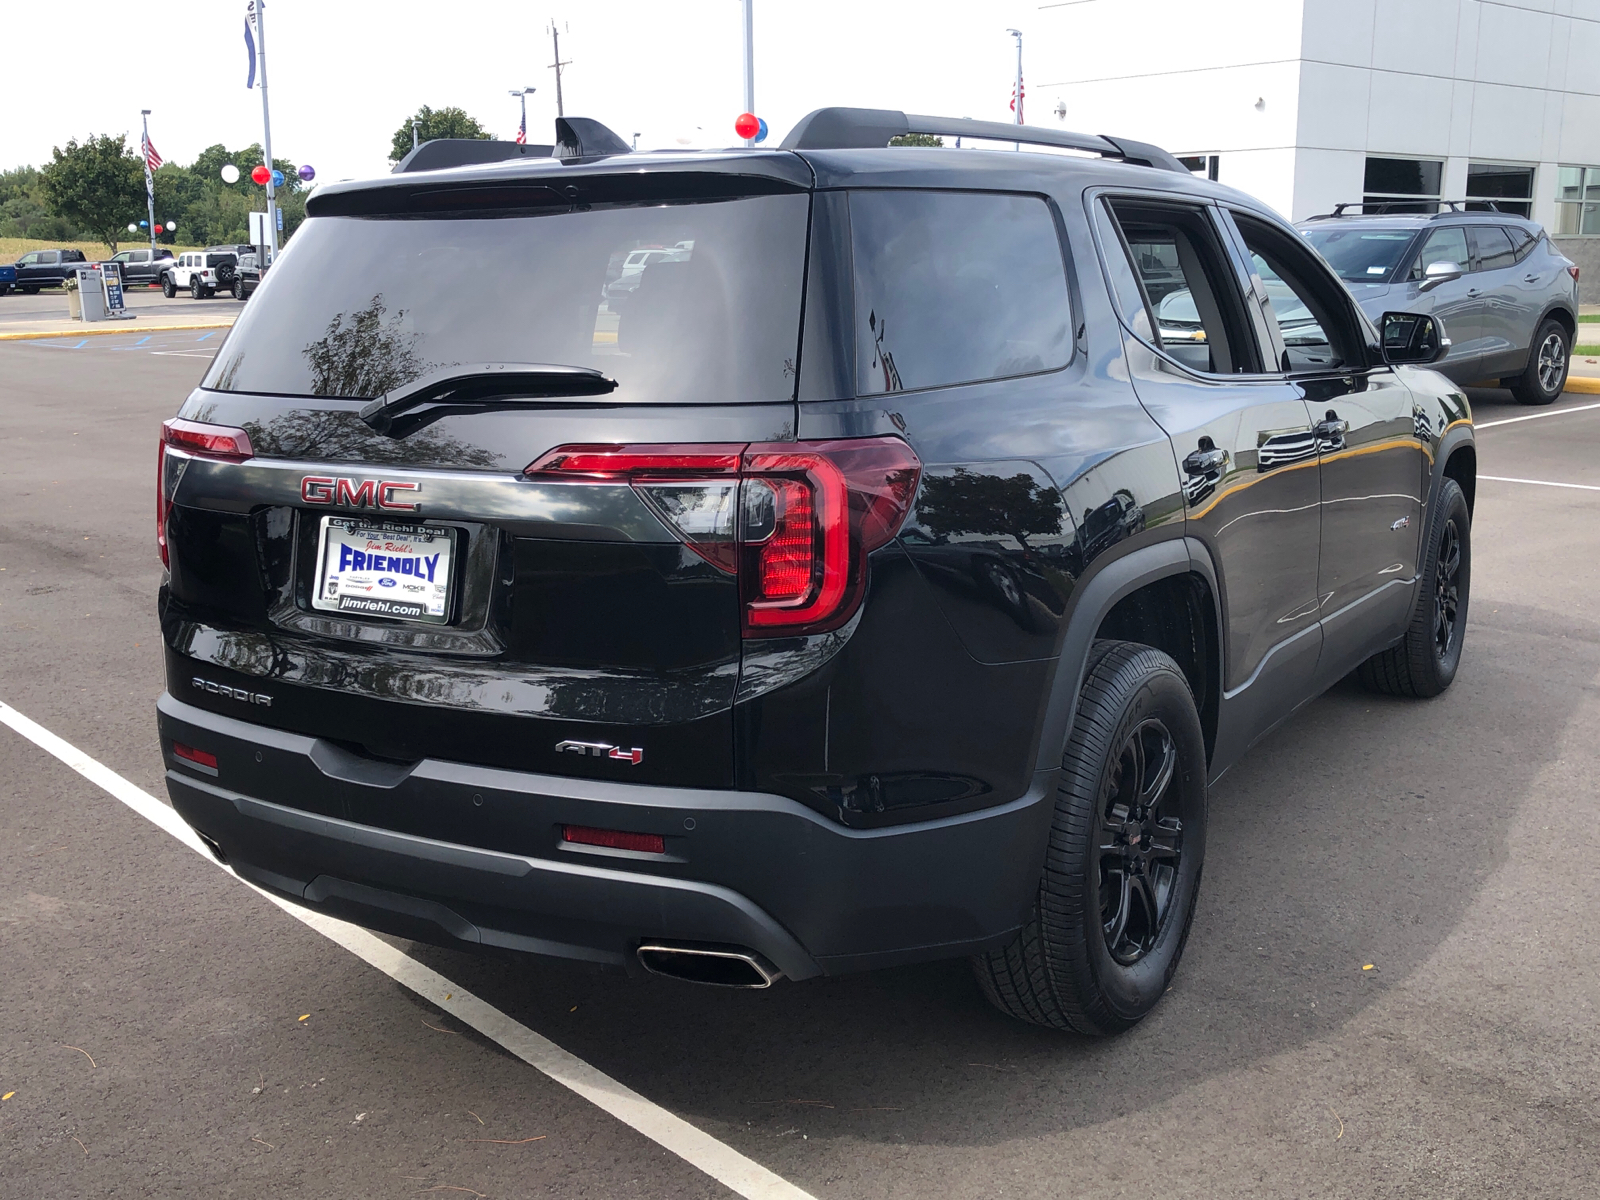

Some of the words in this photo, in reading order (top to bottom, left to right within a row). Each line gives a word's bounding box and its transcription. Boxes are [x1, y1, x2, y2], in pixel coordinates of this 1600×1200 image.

[301, 475, 421, 512] GMC
[333, 519, 356, 528] Get
[382, 523, 414, 533] Riehl
[417, 527, 445, 536] Deal
[355, 530, 366, 538] For
[366, 531, 380, 540] Your
[365, 540, 382, 552] Jim
[384, 542, 413, 553] Riehl's
[339, 542, 441, 583] FRIENDLY
[340, 596, 421, 616] jimriehl.com
[192, 677, 273, 706] ACADIA
[555, 739, 643, 765] AT4
